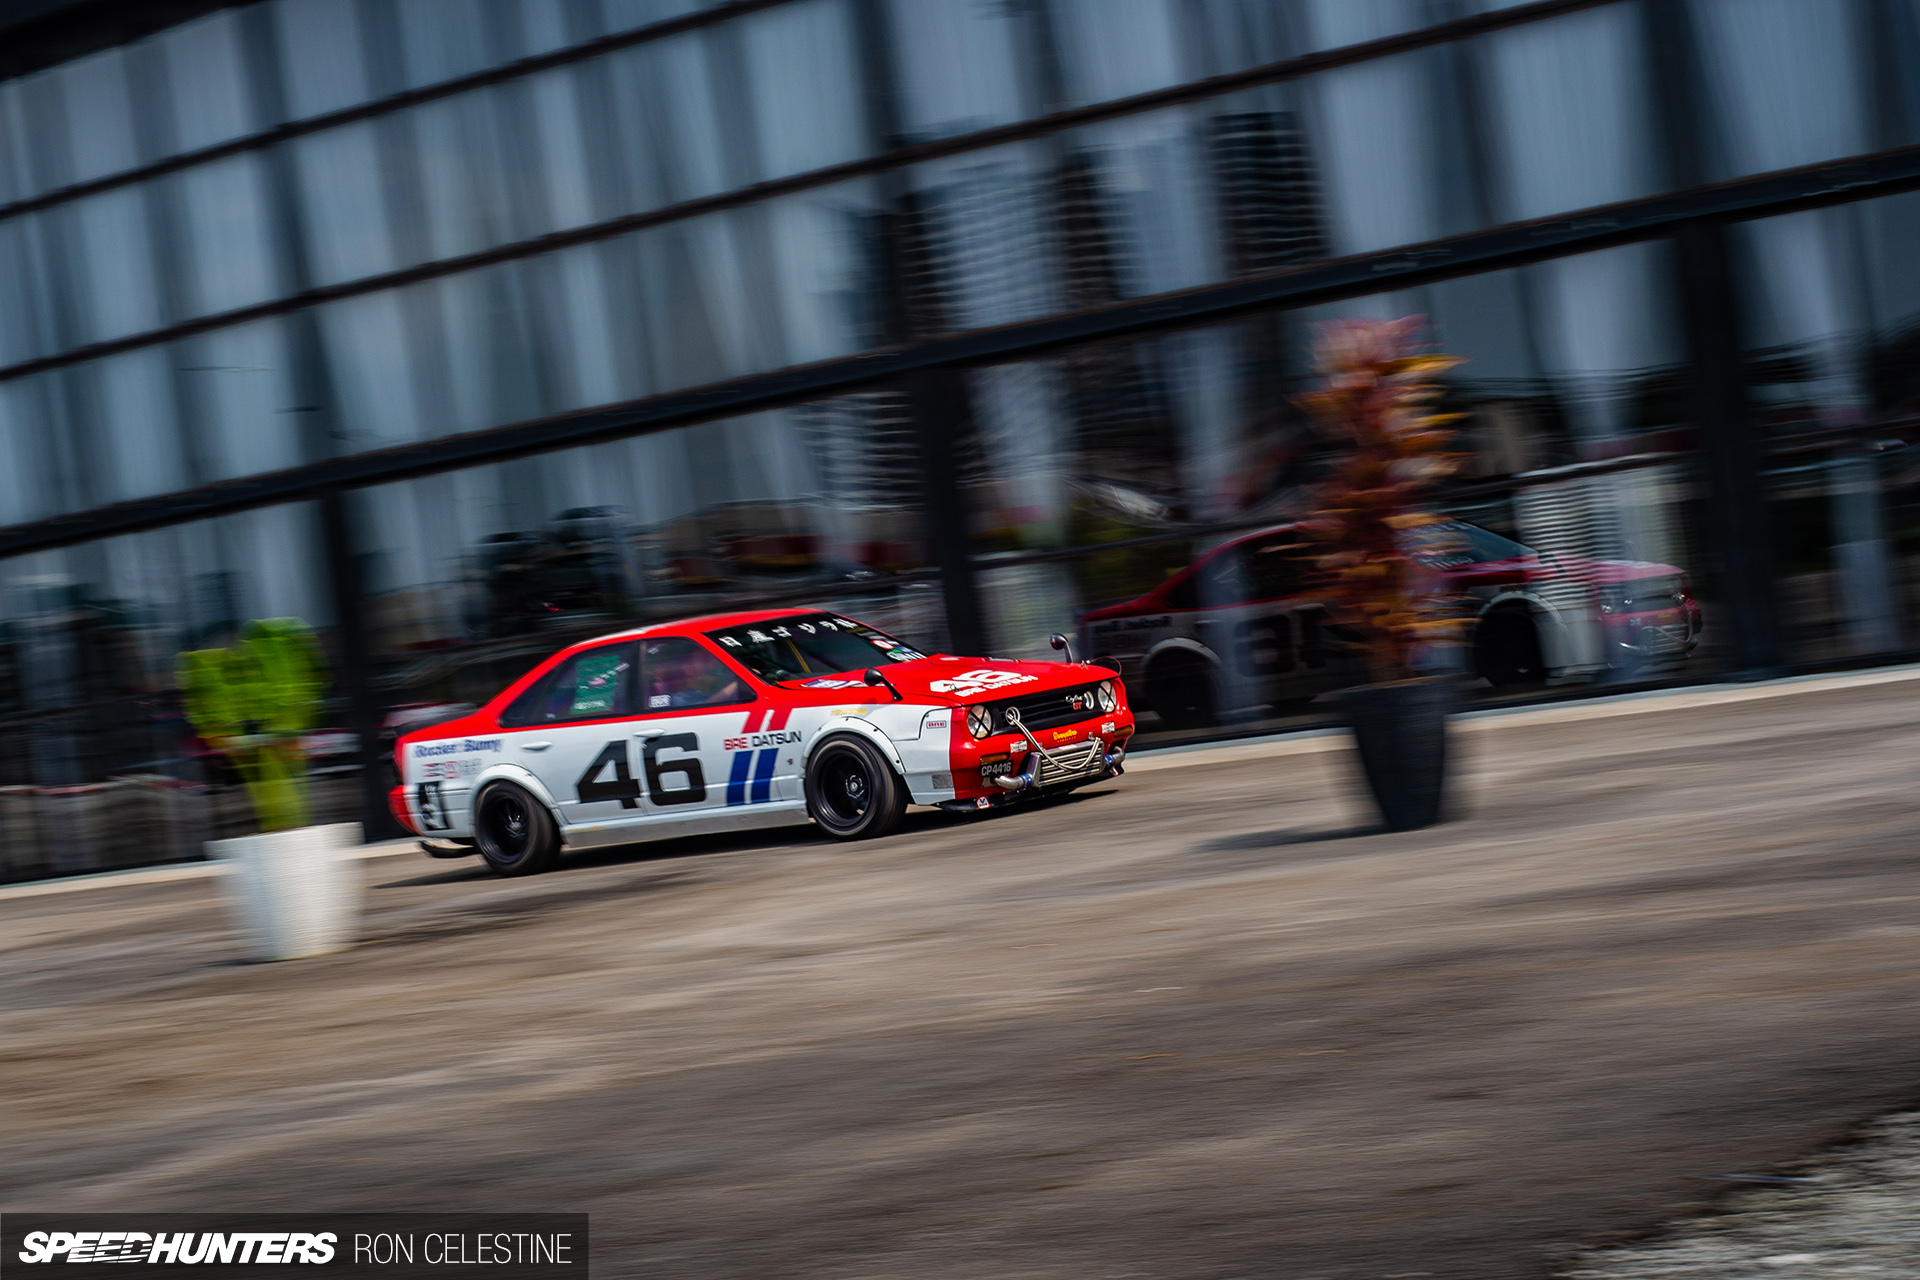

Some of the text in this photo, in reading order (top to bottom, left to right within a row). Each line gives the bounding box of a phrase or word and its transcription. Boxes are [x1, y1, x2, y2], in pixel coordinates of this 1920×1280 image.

[930, 670, 1021, 693] 46
[983, 675, 1038, 689] DATSUN
[724, 731, 801, 750] BRE DATSUN
[576, 731, 706, 809] 46
[981, 762, 1011, 776] CP4416
